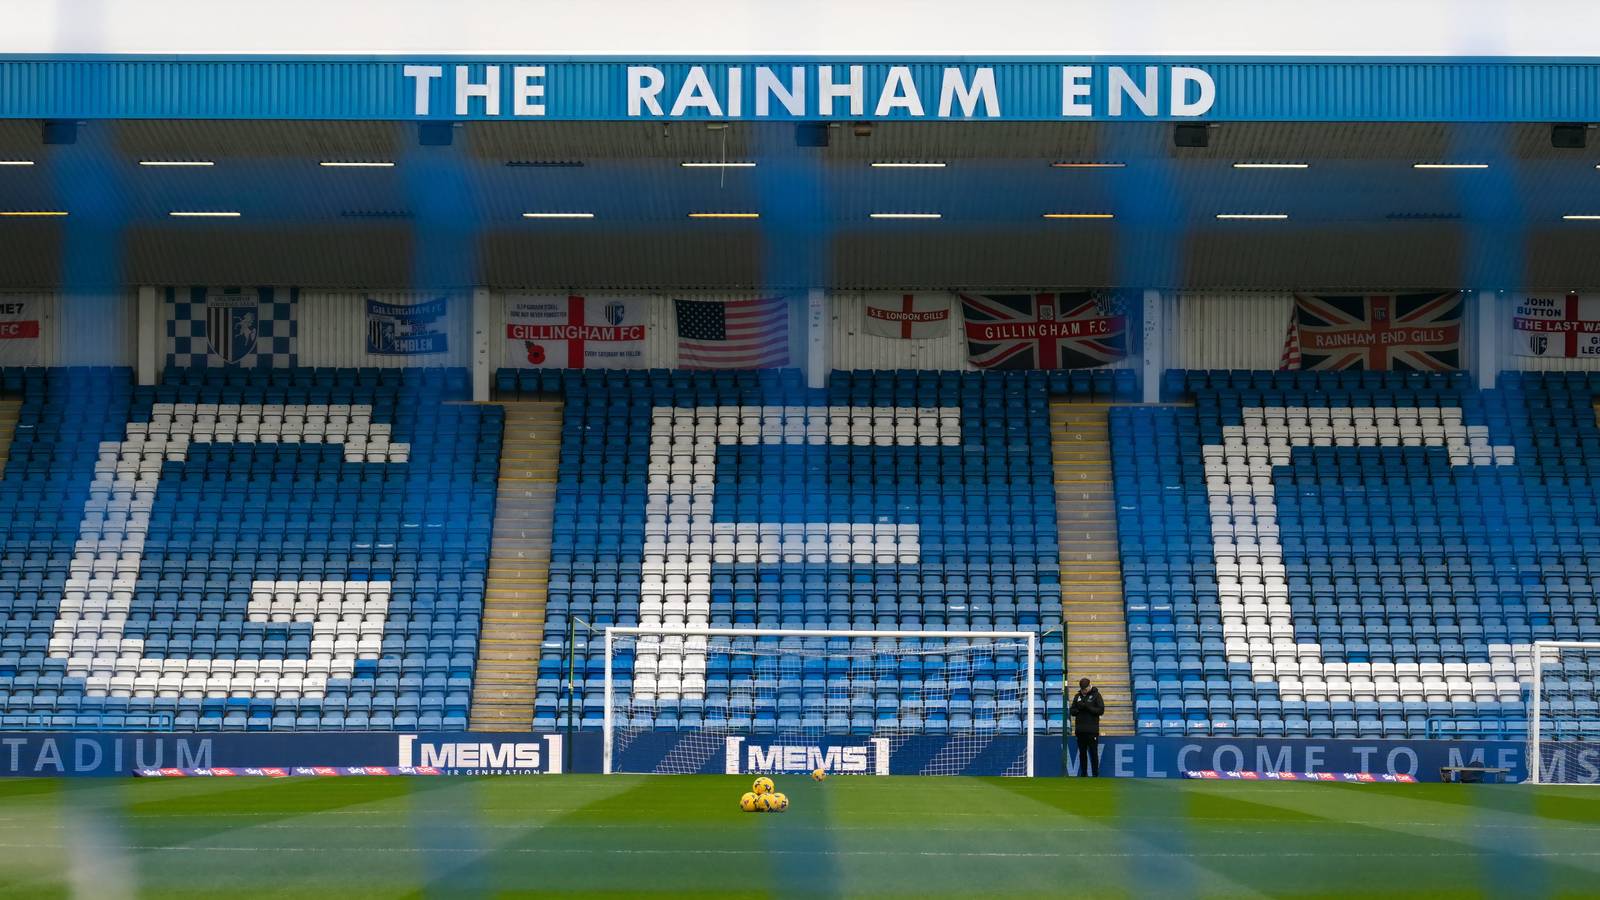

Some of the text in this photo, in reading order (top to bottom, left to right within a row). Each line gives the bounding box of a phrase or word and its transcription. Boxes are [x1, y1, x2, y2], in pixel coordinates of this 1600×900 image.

[403, 65, 1216, 118] THE RAINHAM END
[1524, 298, 1554, 307] JOHN
[886, 312, 921, 322] LONDON
[923, 311, 945, 321] GILLS
[1517, 306, 1561, 317] BUTTON
[0, 323, 20, 335] FC
[985, 321, 1111, 339] GILLINGHAM F.C.
[1516, 320, 1542, 331] THE
[1546, 321, 1580, 332] LAST
[512, 325, 641, 341] GILLINGHAM FC
[1316, 330, 1445, 347] RAINHAM END GILLS
[2, 738, 213, 773] TADIUM
[1060, 744, 1600, 784] WELCOME TO MEMS
[1188, 770, 1201, 778] sky
[1227, 770, 1240, 778] sky
[1266, 771, 1280, 779] sky
[1305, 772, 1318, 780] sky
[1344, 773, 1358, 781] sky
[1383, 774, 1396, 782] sky
